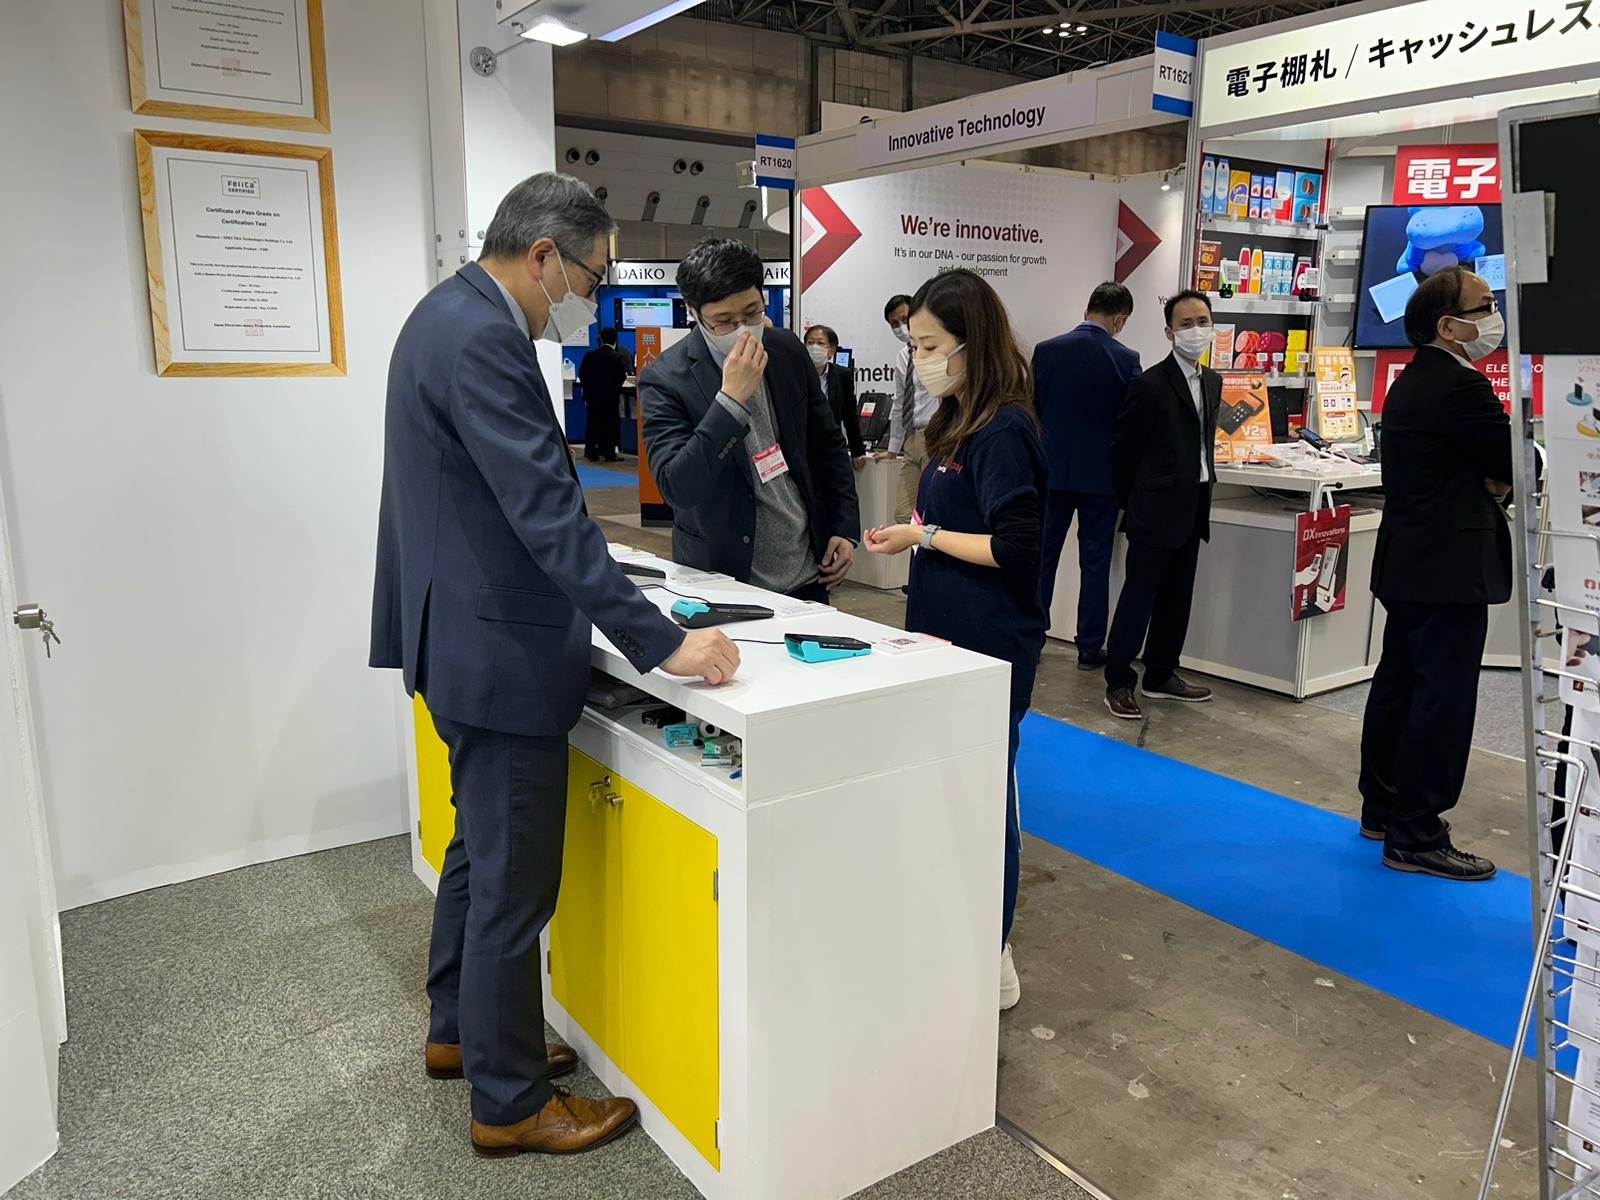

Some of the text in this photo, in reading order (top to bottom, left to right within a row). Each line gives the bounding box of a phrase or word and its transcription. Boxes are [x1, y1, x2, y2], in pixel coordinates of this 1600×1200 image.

[1226, 48, 1337, 97] 電子棚札
[1368, 0, 1593, 69] キャッシュレス
[1160, 65, 1192, 85] RT1621
[888, 106, 1046, 151] Innovative Technology
[760, 156, 792, 168] RT1620
[1407, 158, 1497, 199] 電子
[955, 219, 1043, 244] innovative.
[909, 248, 917, 258] in
[918, 251, 932, 259] our
[934, 249, 954, 260] DNA
[961, 253, 975, 262] our
[977, 252, 1008, 264] passion
[1009, 253, 1021, 264] for
[1021, 255, 1047, 267] growth
[1241, 425, 1267, 437] V2s
